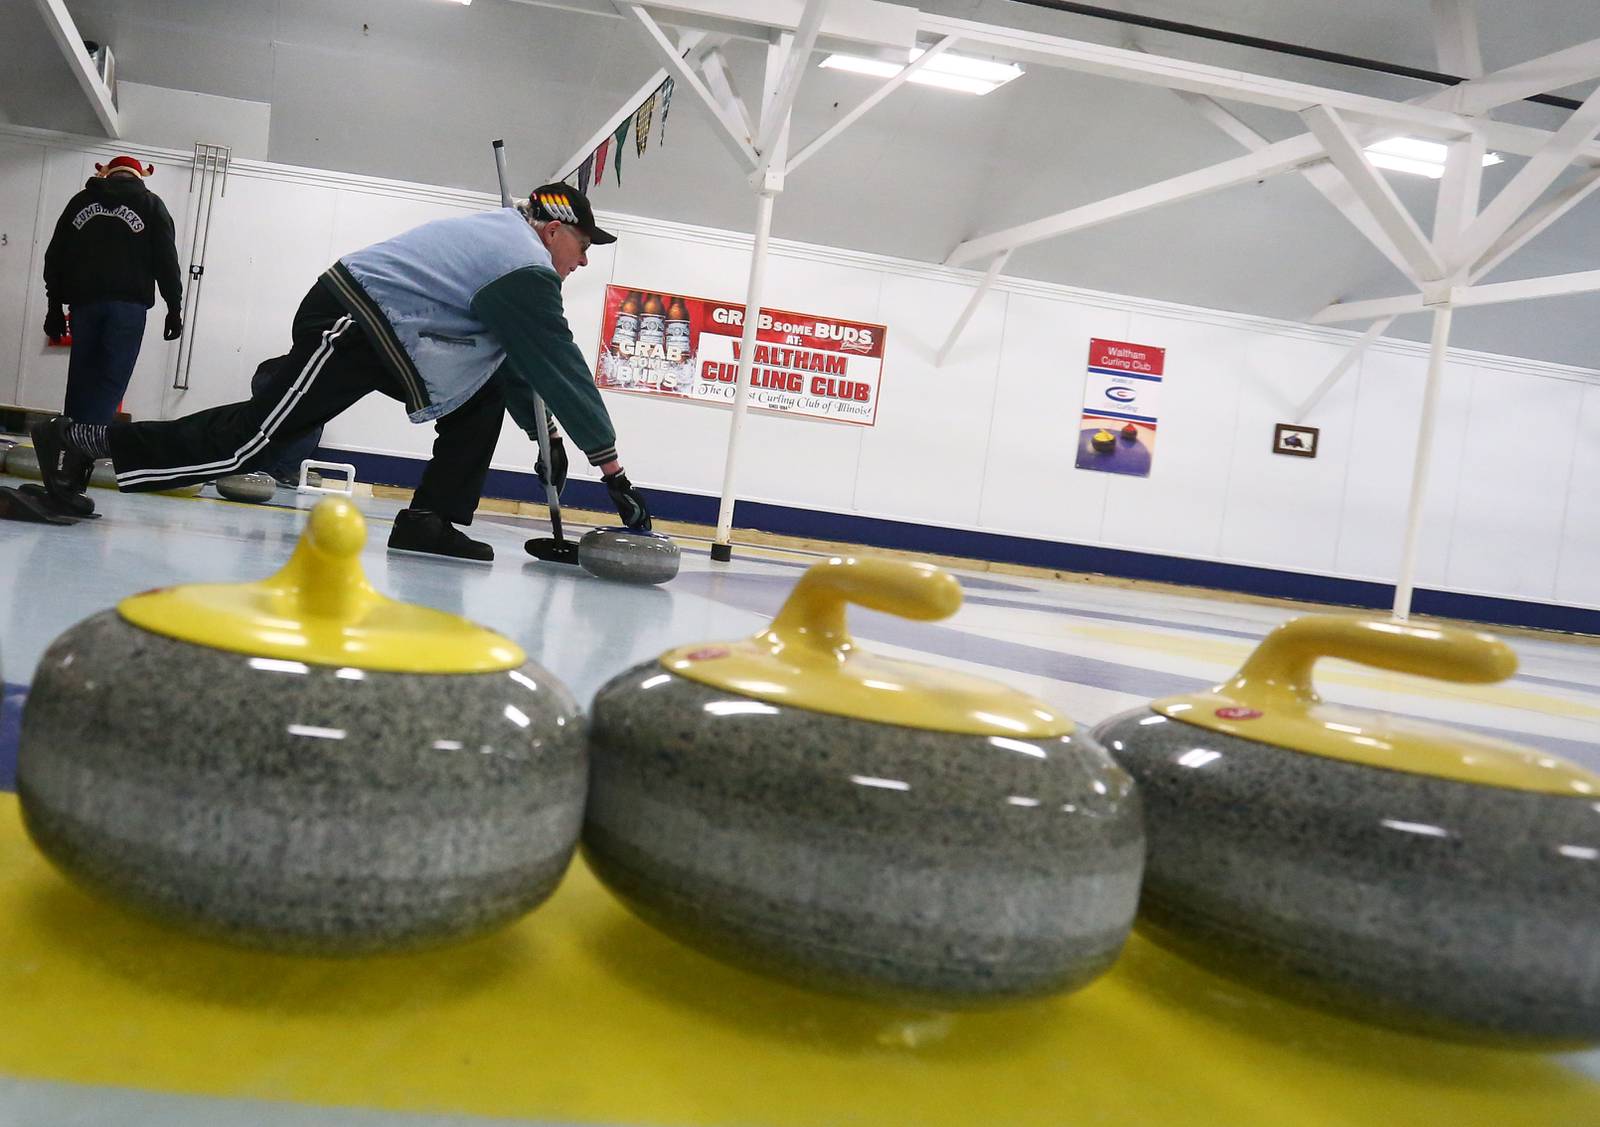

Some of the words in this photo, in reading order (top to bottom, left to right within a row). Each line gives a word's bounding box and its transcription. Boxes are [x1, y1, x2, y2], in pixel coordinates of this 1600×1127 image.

[713, 307, 773, 330] GRB
[773, 321, 813, 336] SOME
[814, 322, 873, 345] BUDS
[619, 338, 682, 361] GRAB
[786, 335, 803, 346] AT:
[628, 355, 671, 371] SOME
[1101, 355, 1131, 370] Curling
[1132, 360, 1153, 371] Club
[1107, 346, 1147, 361] Waltham
[617, 365, 678, 389] BUDS
[701, 360, 804, 394] CULING
[810, 376, 871, 403] CLUB
[698, 383, 722, 396] The
[724, 386, 756, 400] Ost
[758, 391, 795, 409] Curling
[796, 397, 820, 409] Club
[821, 400, 834, 414] of
[835, 402, 872, 417] Illinois!
